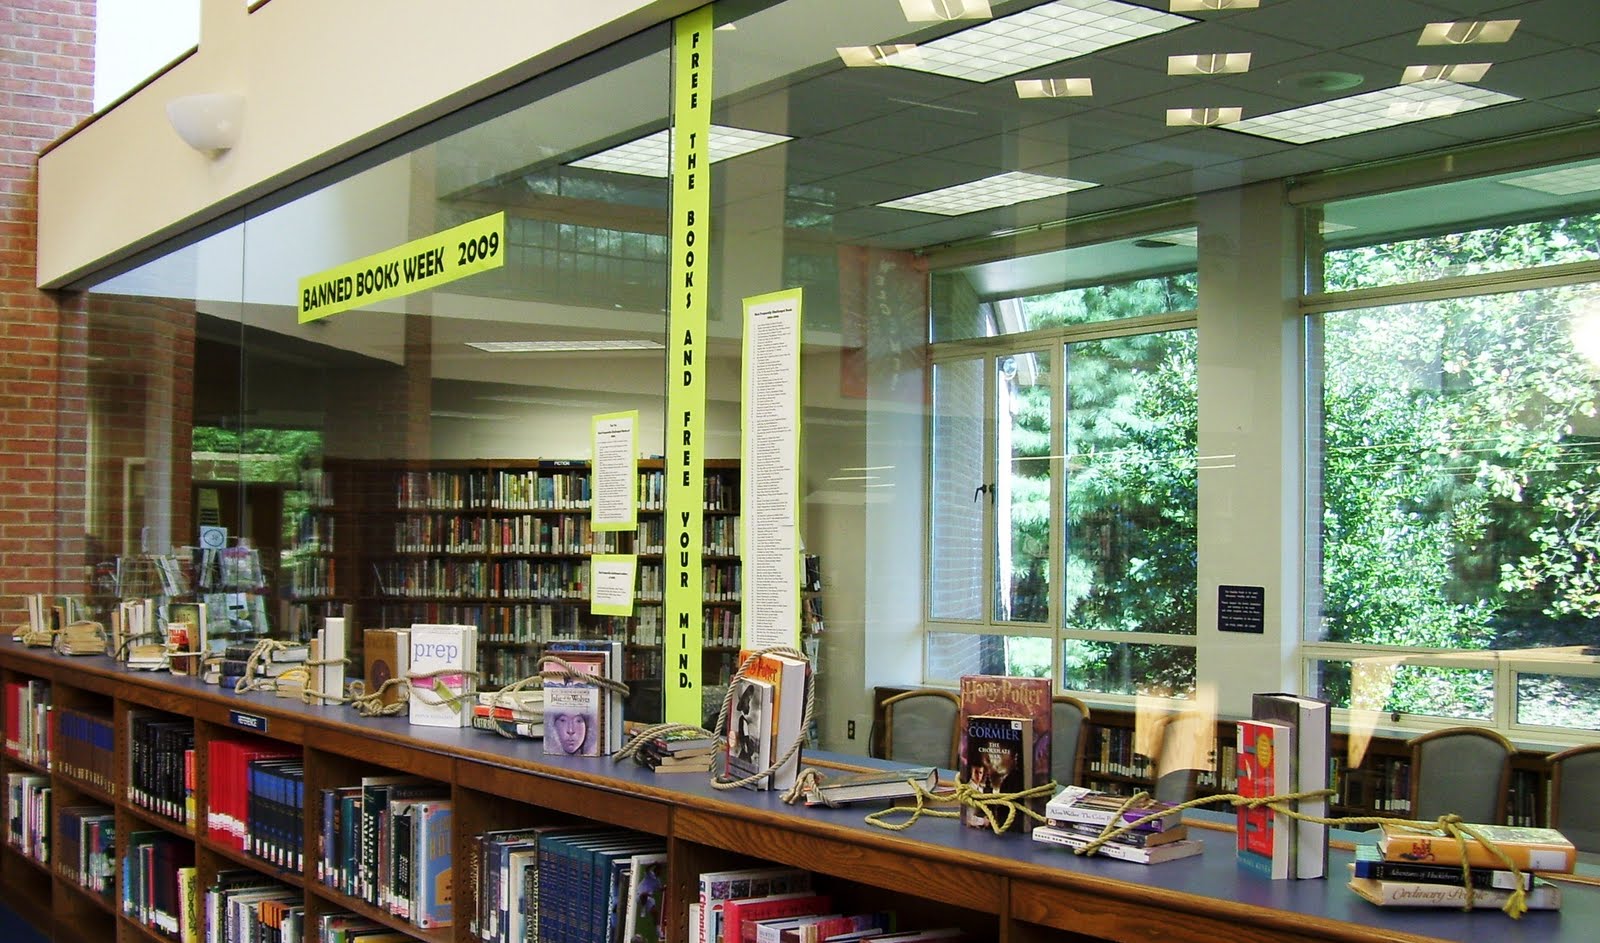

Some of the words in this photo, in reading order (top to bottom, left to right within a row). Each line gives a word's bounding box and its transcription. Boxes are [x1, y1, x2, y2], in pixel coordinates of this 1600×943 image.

[690, 32, 700, 110] FREE
[687, 133, 697, 190] THE
[302, 276, 352, 312] BANNED
[356, 260, 400, 297] BOOKS
[402, 246, 445, 284] WEEK
[457, 231, 499, 267] 2009
[685, 210, 695, 309] BOOKS
[683, 329, 693, 387] AND
[682, 411, 691, 487] FREE
[679, 511, 690, 588] YOUR
[413, 642, 458, 664] prep
[678, 612, 692, 689] MIND.
[962, 679, 1001, 705] Harry
[1001, 679, 1043, 706] Potter
[968, 726, 1020, 740] CORMIER
[1392, 886, 1447, 903] Ordinary
